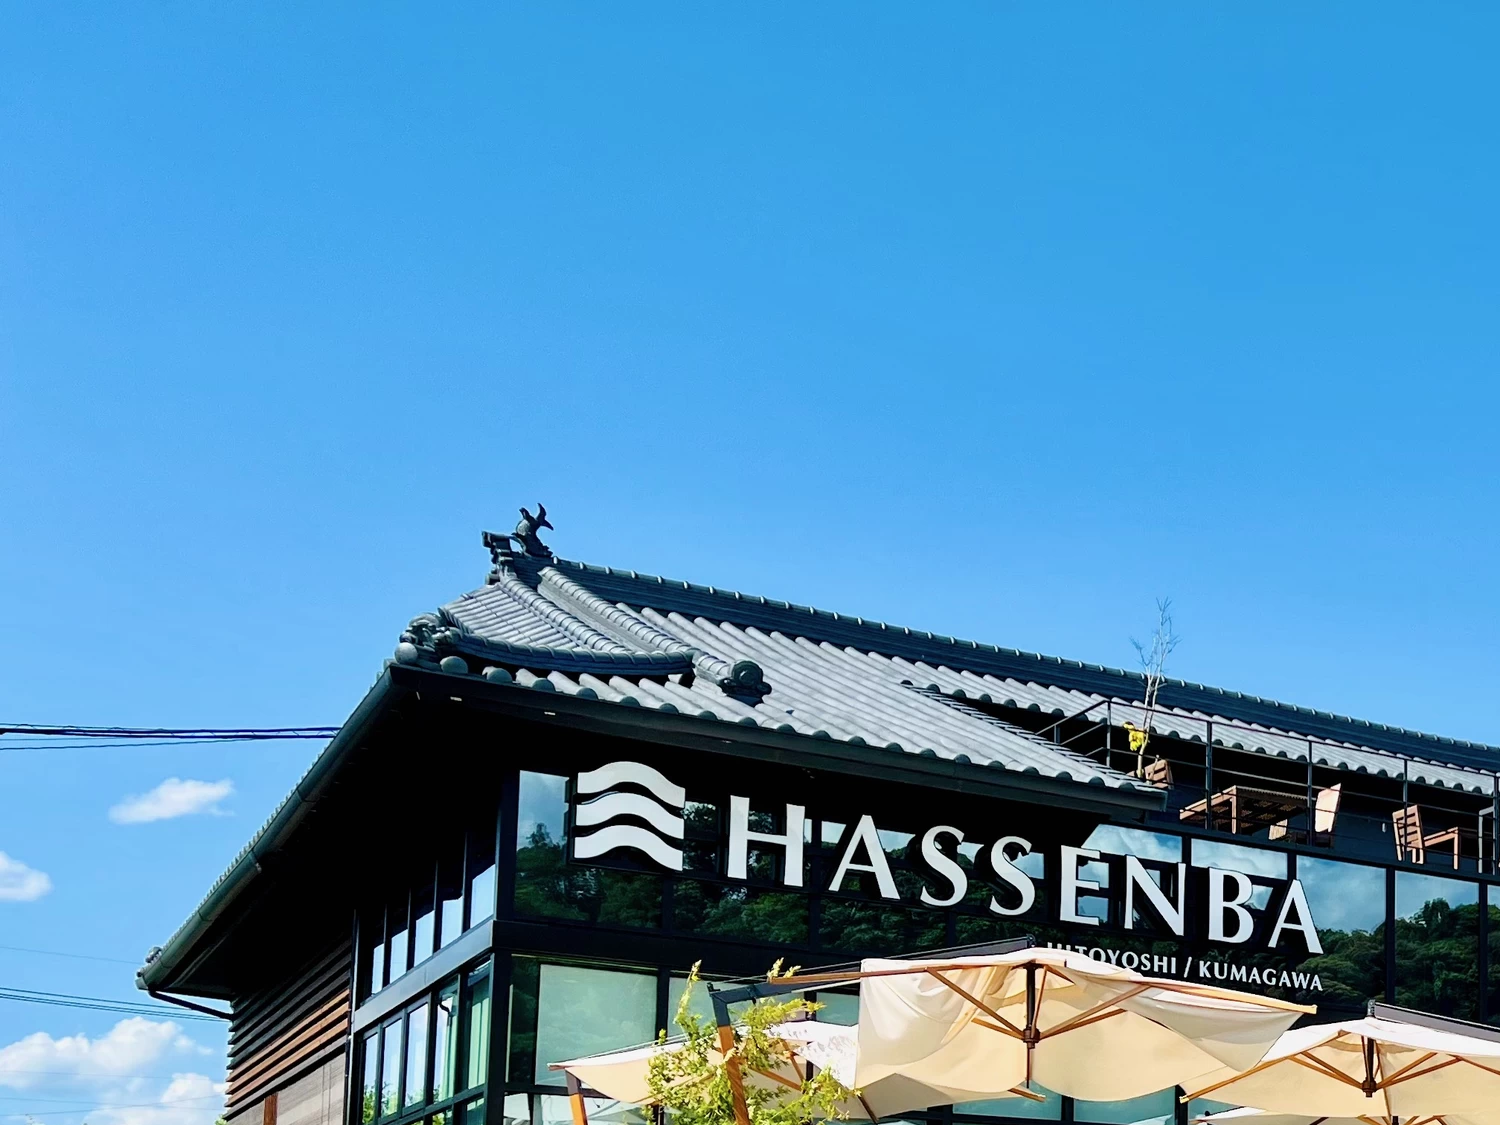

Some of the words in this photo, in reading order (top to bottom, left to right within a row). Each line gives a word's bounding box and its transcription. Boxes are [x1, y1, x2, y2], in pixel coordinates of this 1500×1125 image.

[727, 795, 1324, 954] HASSENBA
[1183, 956, 1193, 978] /
[1199, 960, 1323, 991] KUMAGAWA
